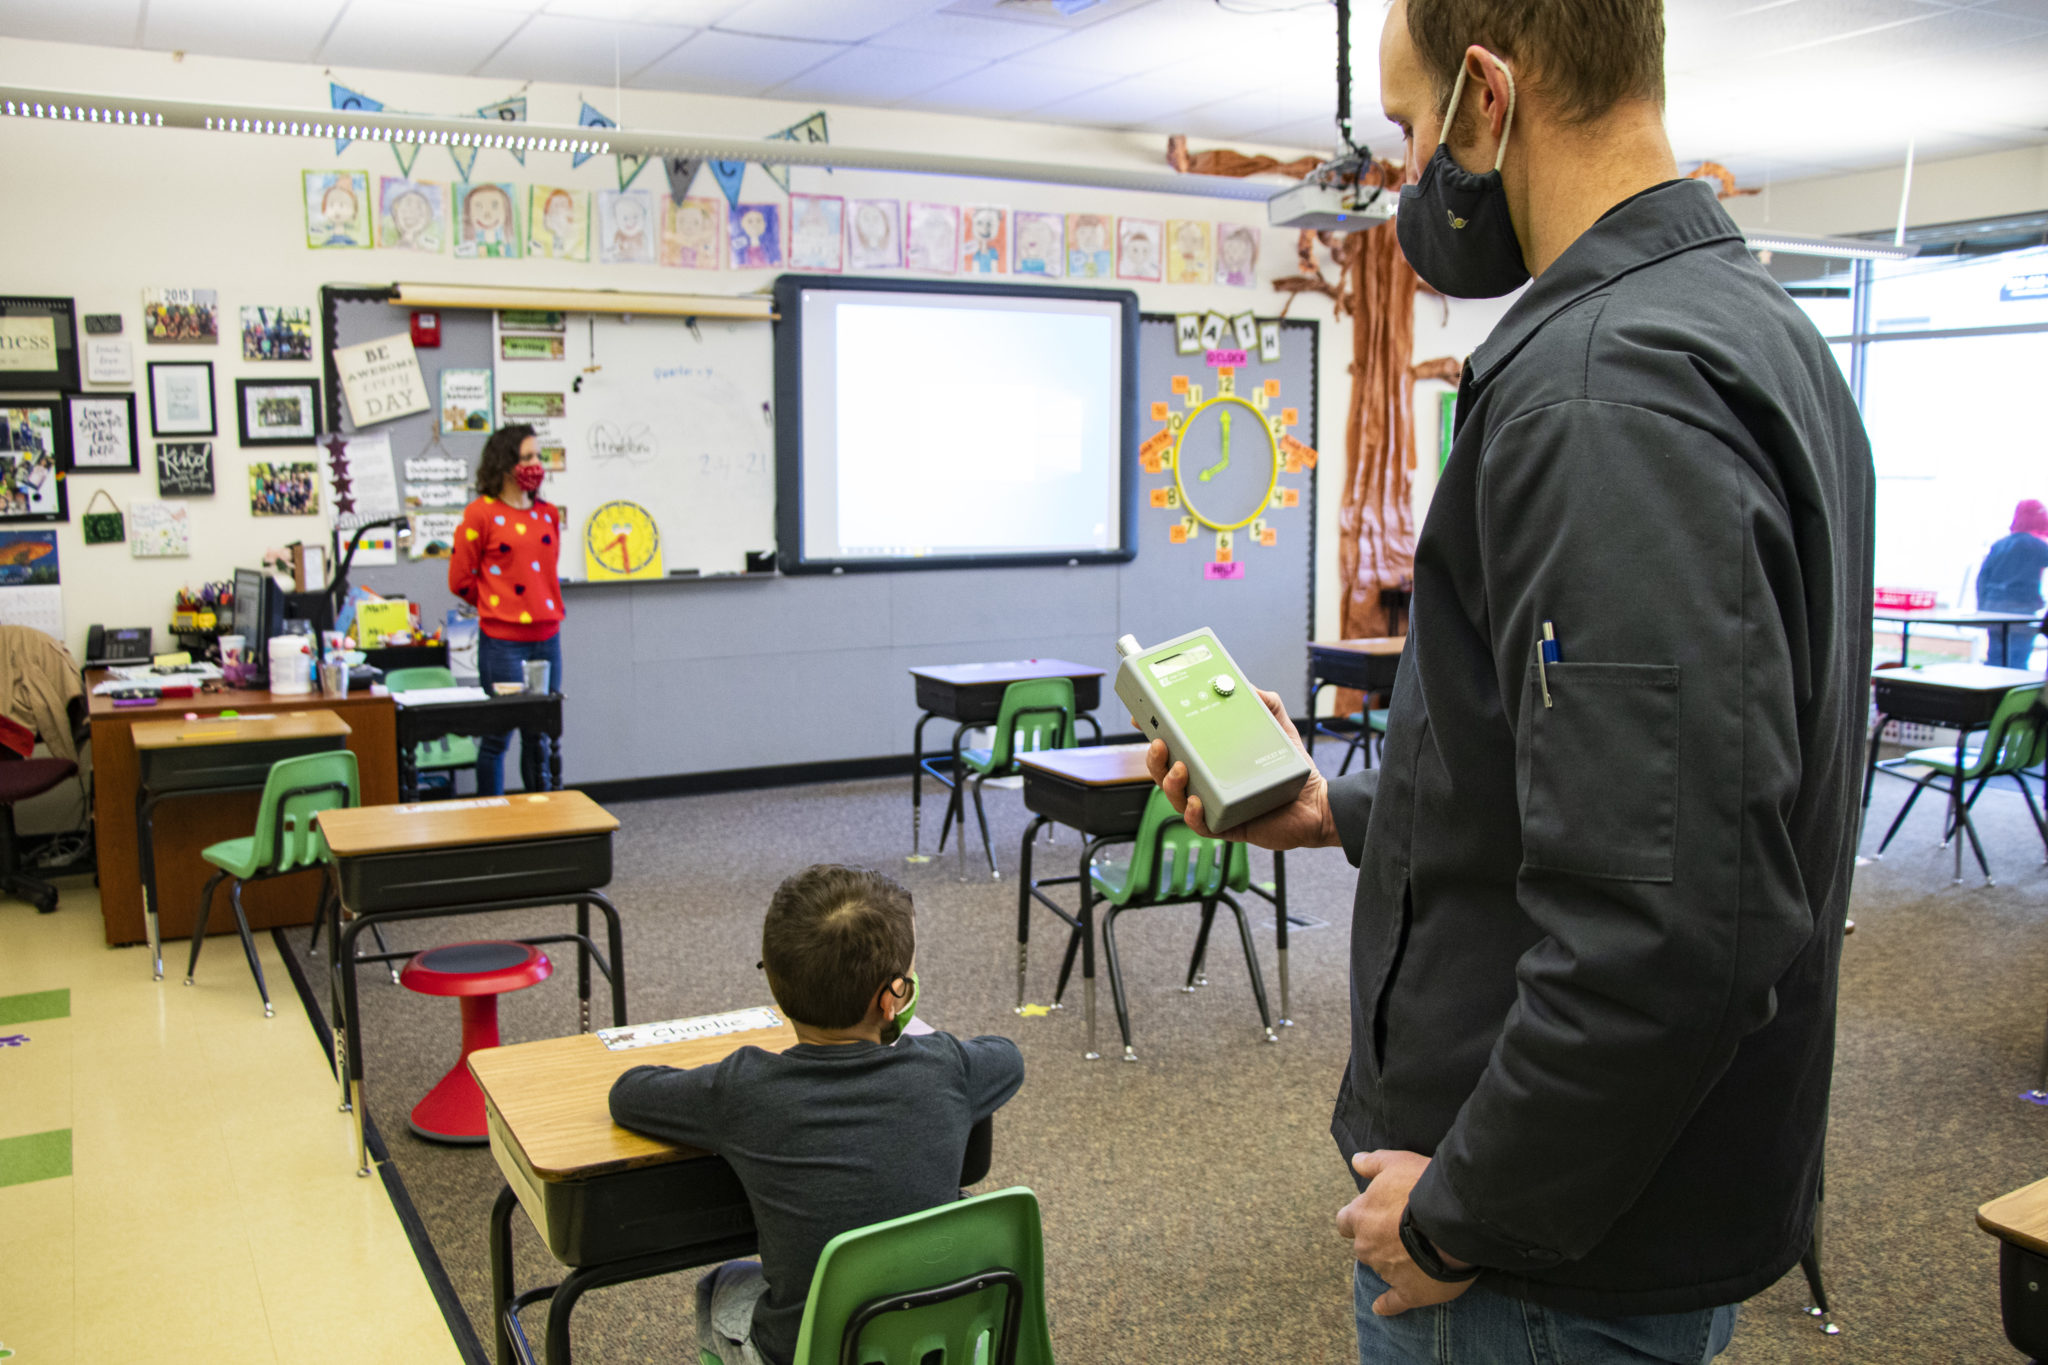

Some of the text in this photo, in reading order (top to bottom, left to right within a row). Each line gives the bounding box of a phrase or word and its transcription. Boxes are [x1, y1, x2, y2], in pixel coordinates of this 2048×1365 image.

[164, 288, 189, 301] 2015
[365, 344, 390, 363] BE
[348, 358, 415, 382] AWESOME
[1218, 376, 1233, 393] 12
[366, 389, 414, 417] DAY
[653, 1019, 743, 1038] Charlie
